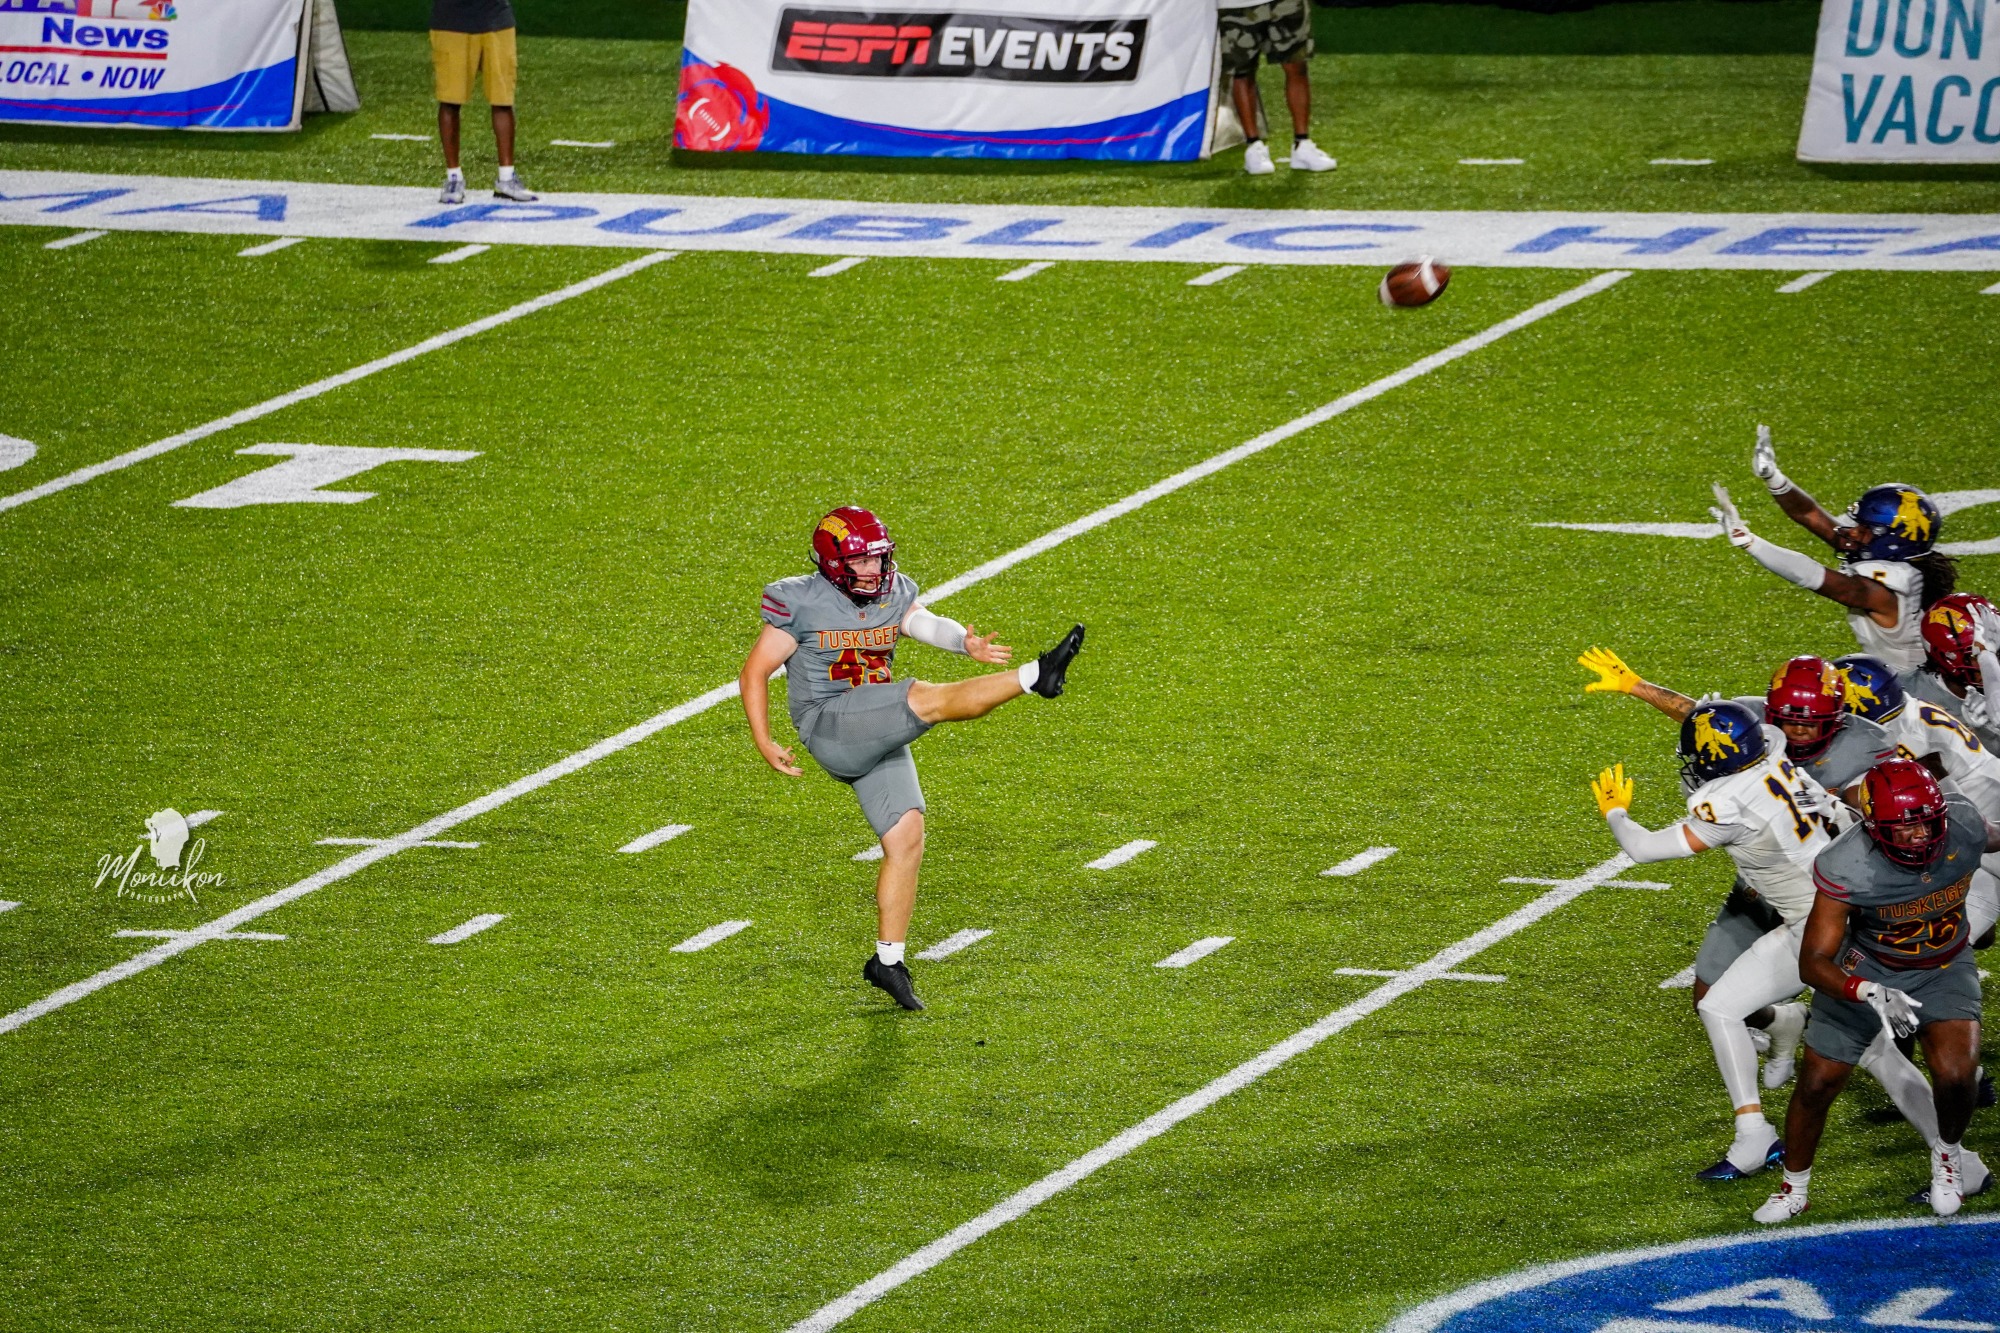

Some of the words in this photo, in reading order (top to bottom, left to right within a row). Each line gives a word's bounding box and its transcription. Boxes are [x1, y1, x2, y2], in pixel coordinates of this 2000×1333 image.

[42, 16, 169, 50] News
[785, 21, 932, 65] ESPN
[938, 26, 1135, 71] EVENTS
[100, 66, 166, 90] NOW
[405, 203, 1424, 252] PUBLIC
[816, 624, 899, 649] TUSKEGEE
[828, 647, 892, 689] 45
